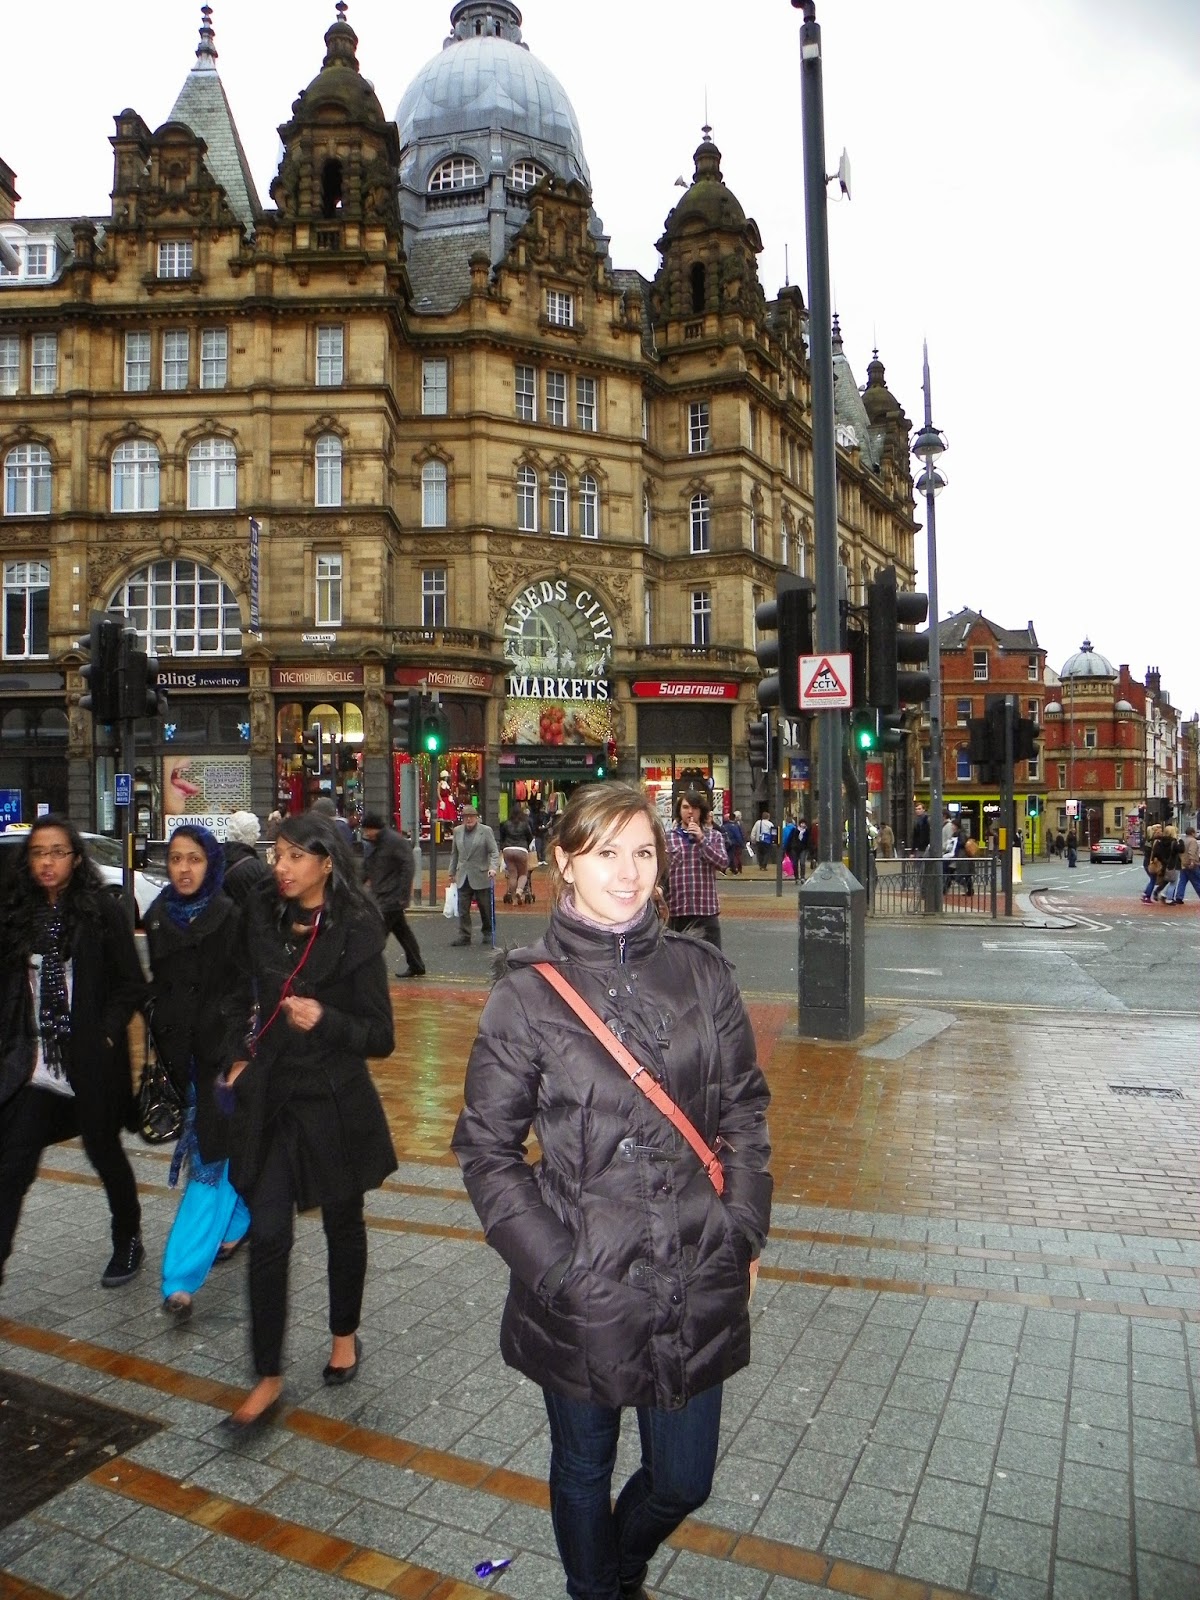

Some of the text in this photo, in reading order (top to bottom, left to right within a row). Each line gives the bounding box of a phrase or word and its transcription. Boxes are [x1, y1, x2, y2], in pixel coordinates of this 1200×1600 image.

[504, 580, 613, 640] LEEDS CITY
[156, 673, 241, 688] Bling Jewellery
[280, 670, 355, 683] MEMPHIS BELLE
[468, 674, 486, 687] BELLE
[508, 675, 609, 700] MARKETS
[659, 683, 725, 695] Supernews
[812, 680, 838, 688] CCTV
[167, 817, 214, 827] COMING
